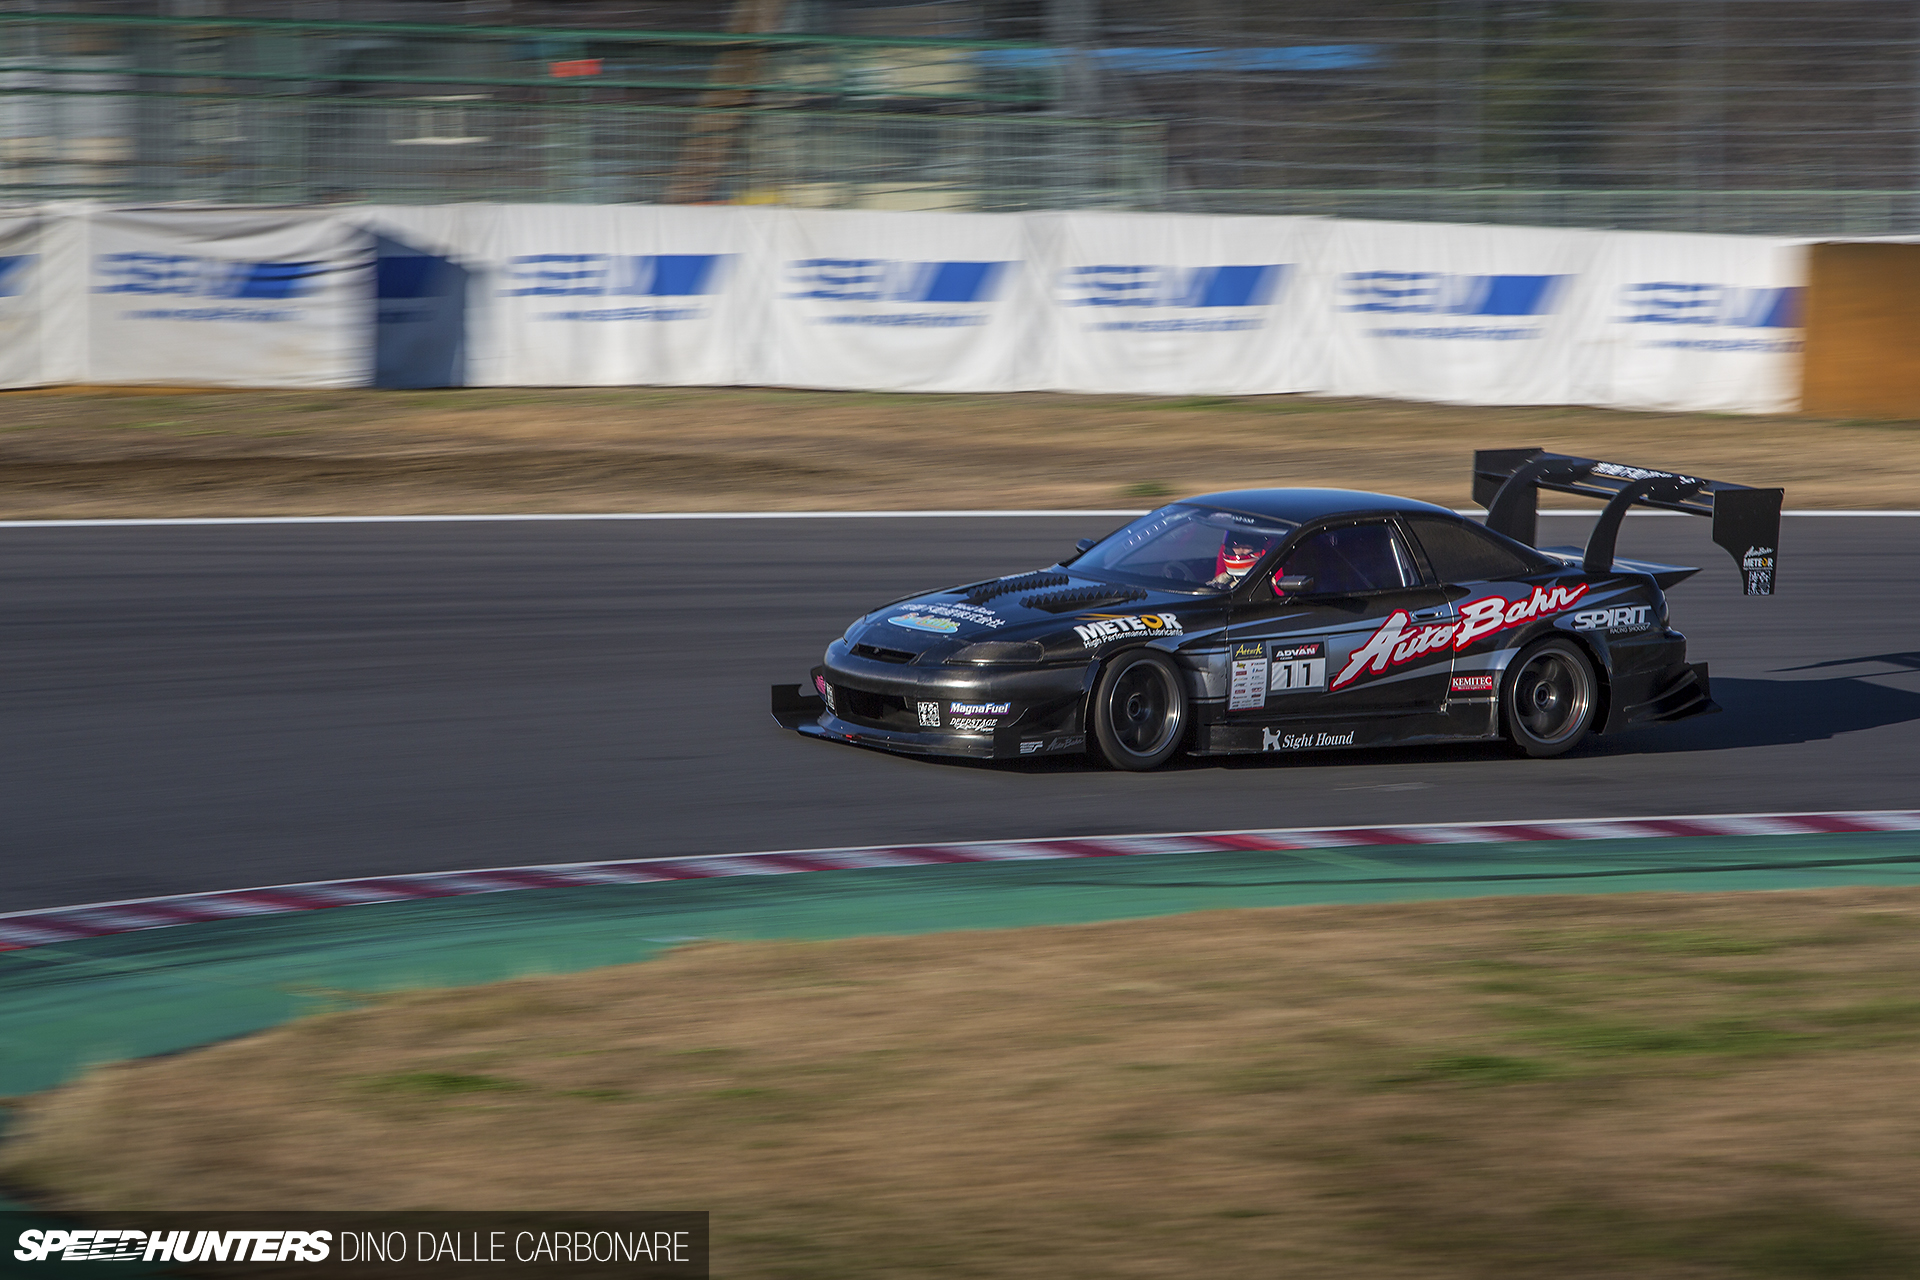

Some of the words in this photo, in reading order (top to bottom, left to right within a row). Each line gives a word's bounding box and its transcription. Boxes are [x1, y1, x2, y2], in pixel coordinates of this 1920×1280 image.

[1743, 557, 1773, 567] METEOR
[1073, 613, 1182, 641] METEOR
[1575, 605, 1652, 630] SPIRIT
[1082, 638, 1102, 649] High
[1102, 629, 1148, 644] Performance
[1148, 627, 1183, 636] Lubricants
[1276, 647, 1316, 658] ADVAN
[1283, 663, 1311, 688] 11
[1452, 676, 1492, 686] KEMITEC
[950, 702, 1009, 716] MagnaFuel
[1282, 732, 1314, 749] Sight
[1315, 730, 1355, 747] Hound
